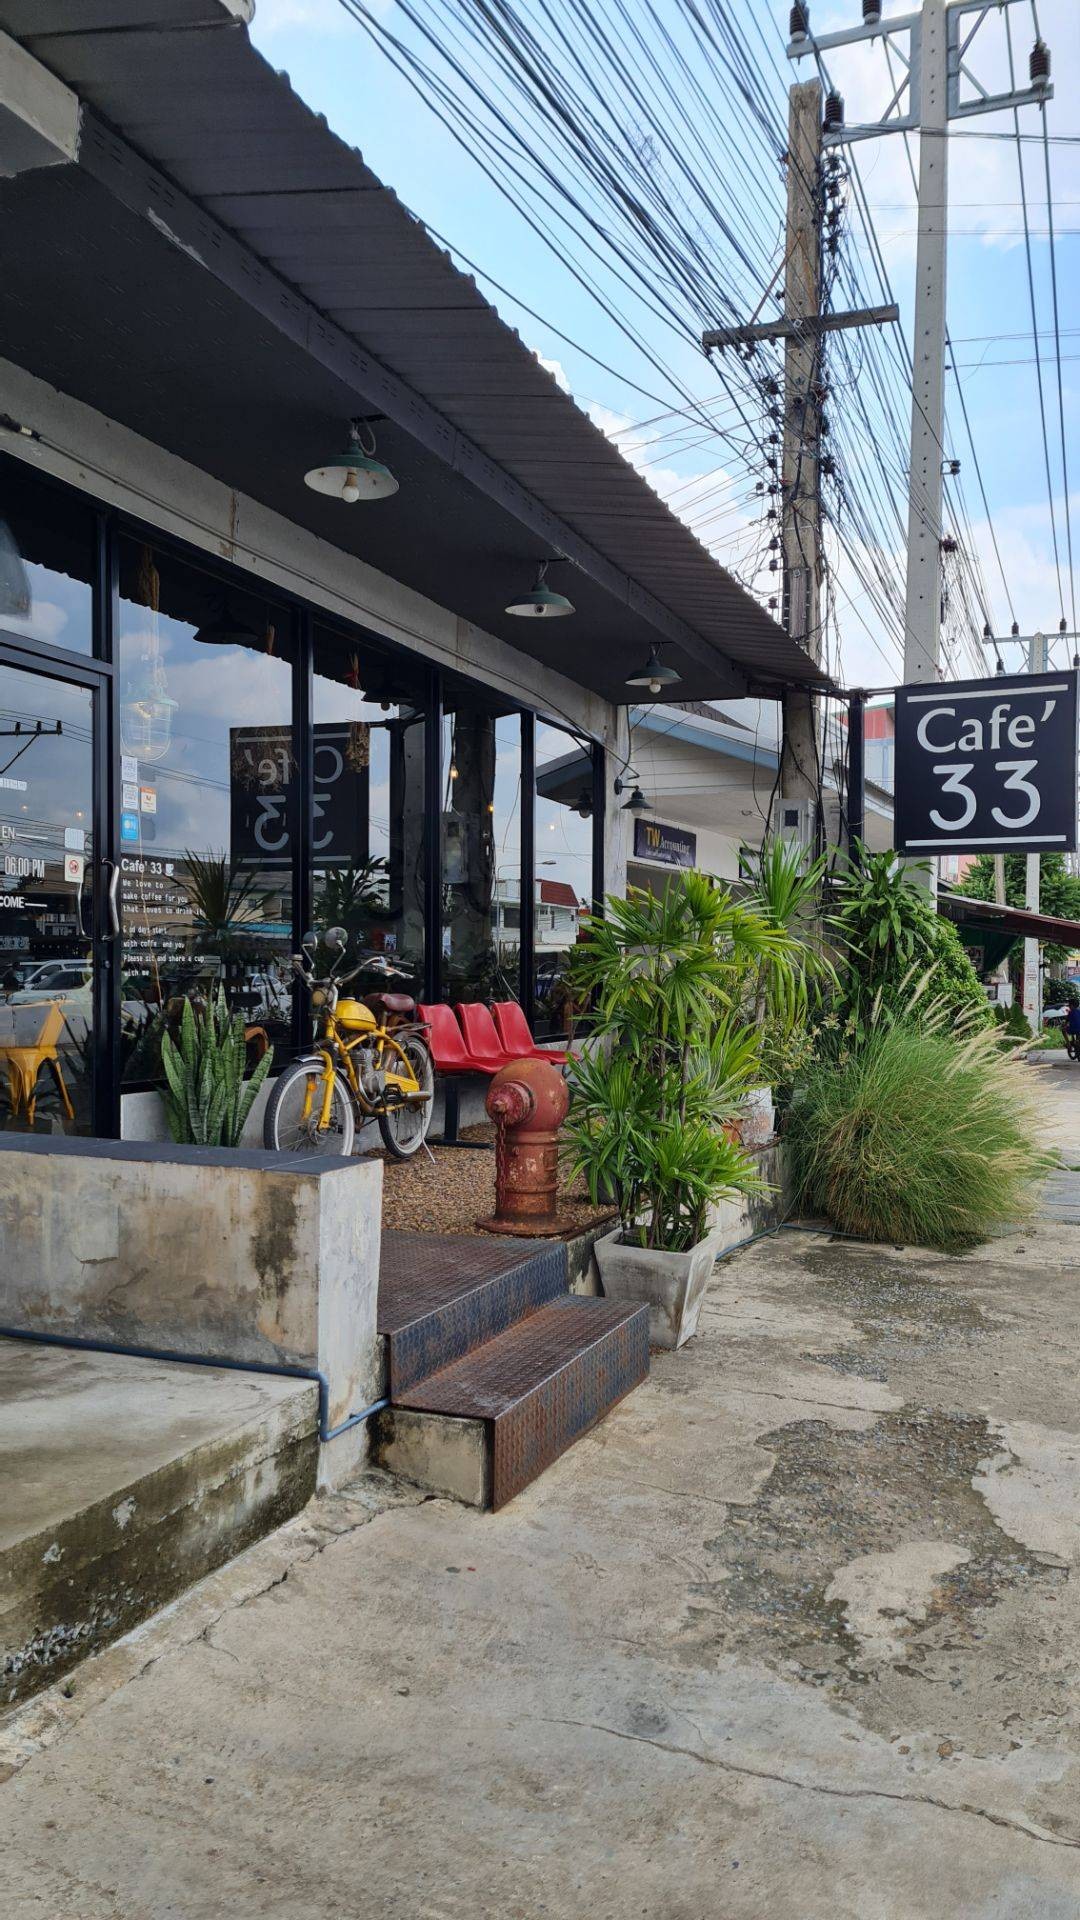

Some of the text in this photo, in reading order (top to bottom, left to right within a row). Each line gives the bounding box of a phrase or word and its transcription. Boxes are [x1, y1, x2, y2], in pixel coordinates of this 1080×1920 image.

[917, 700, 1056, 753] Cafe'
[929, 760, 1041, 831] 33
[646, 826, 660, 848] TW
[32, 859, 45, 878] PM
[150, 861, 162, 875] 33
[122, 879, 131, 887] We
[135, 880, 152, 888] love
[141, 892, 163, 901] coffee
[165, 893, 176, 902] for
[123, 905, 139, 913] that
[143, 905, 162, 914] loves
[123, 939, 138, 948] with
[194, 956, 205, 964] cup
